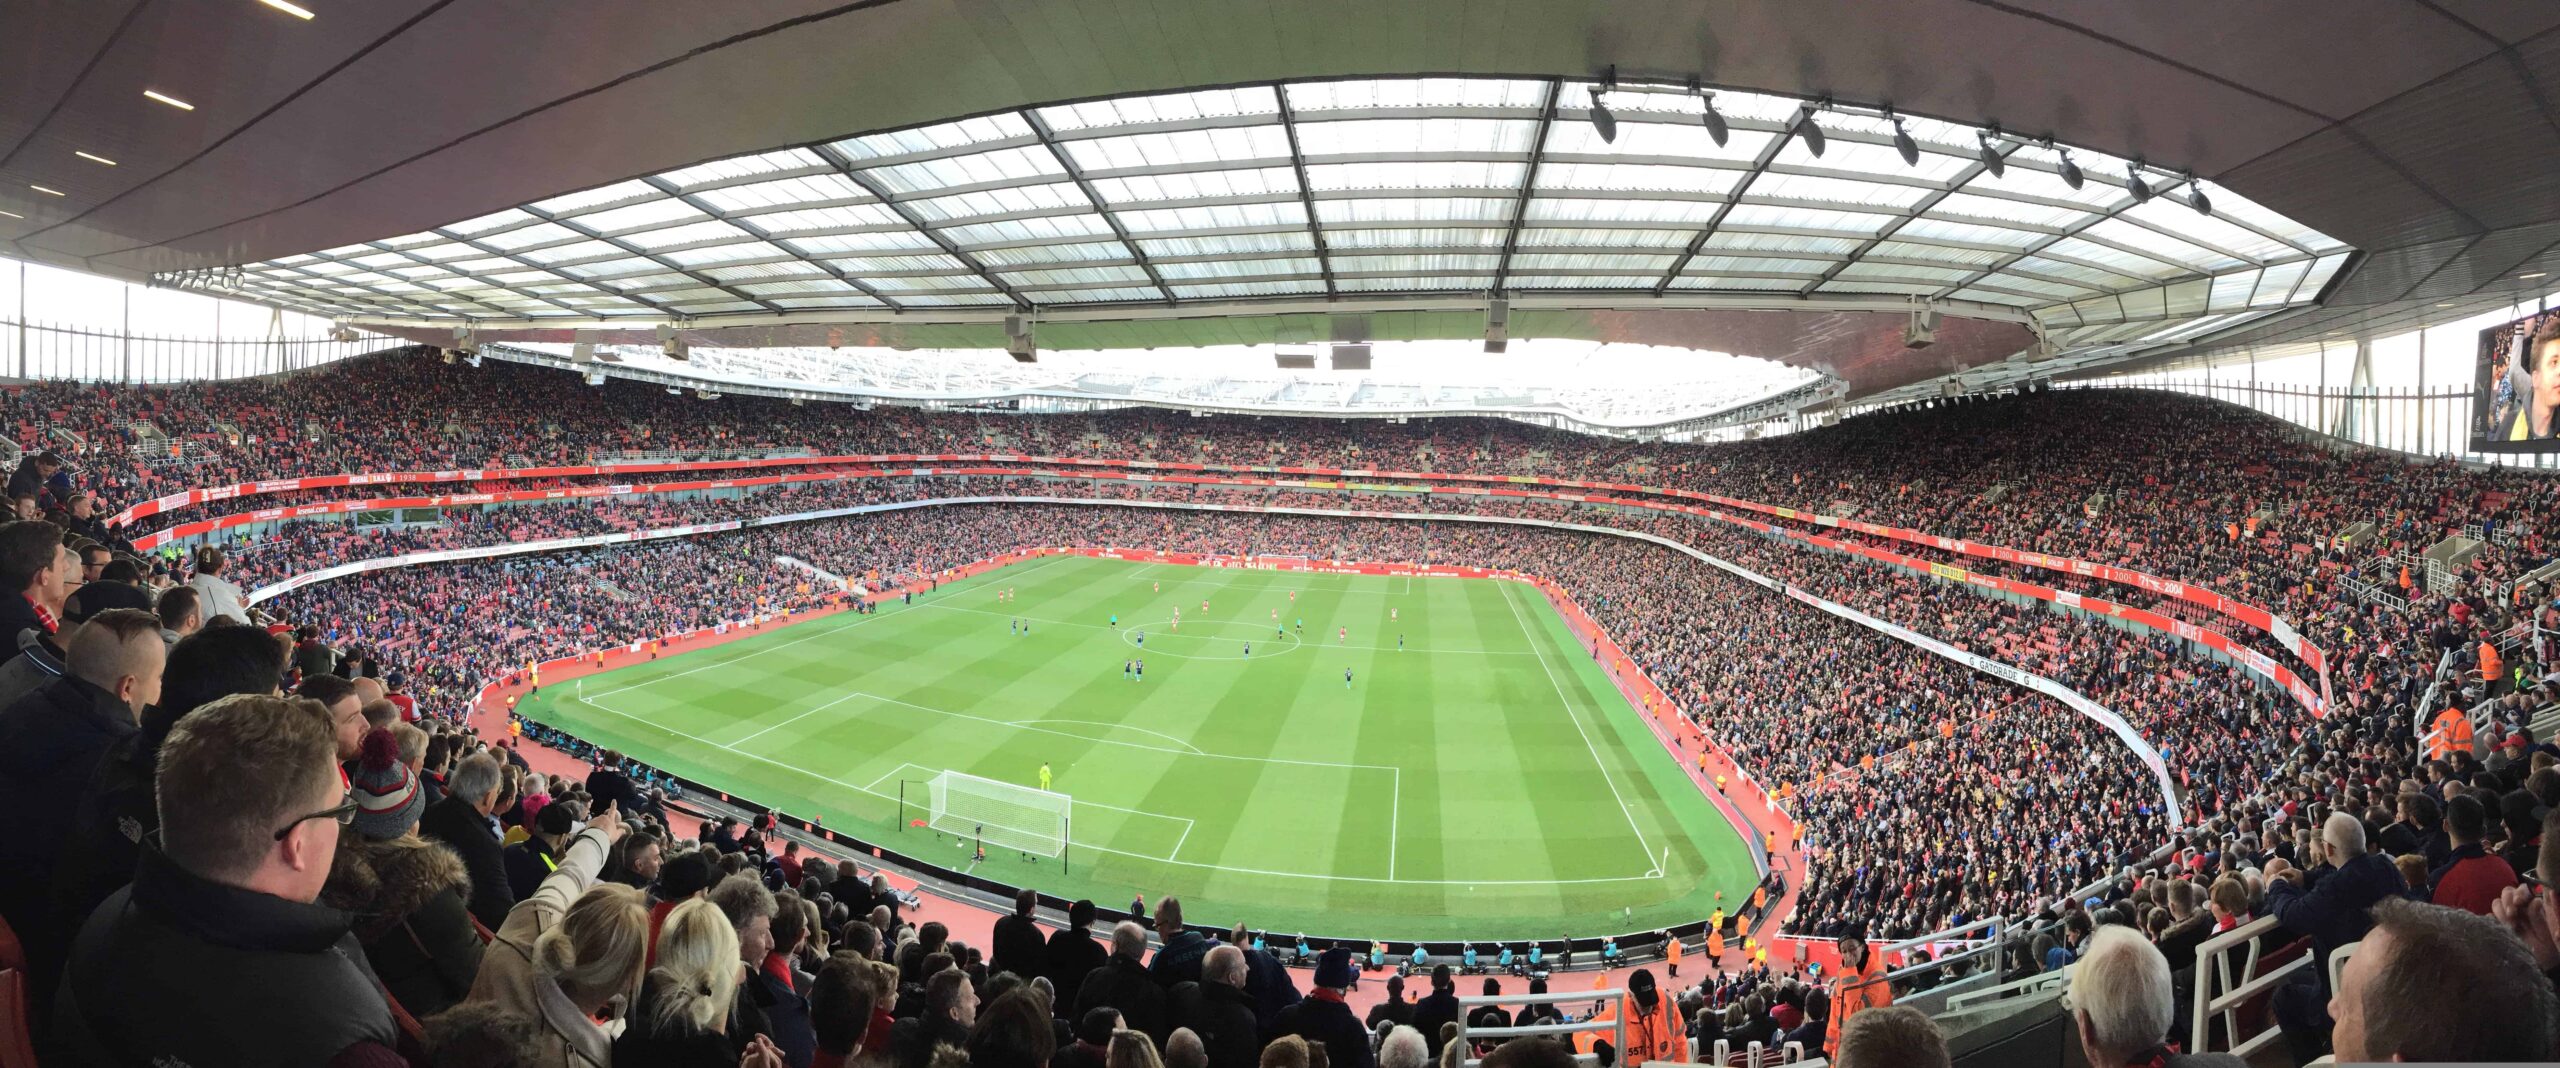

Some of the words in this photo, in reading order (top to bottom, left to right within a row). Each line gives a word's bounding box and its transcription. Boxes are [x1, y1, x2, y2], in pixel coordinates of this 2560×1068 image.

[296, 506, 328, 515] Arsenal.com
[1938, 537, 1952, 550] WHL
[2000, 551, 2013, 559] 2004
[2114, 572, 2132, 583] 2005
[2138, 574, 2148, 586] '71
[2164, 582, 2183, 596] 2004
[2226, 642, 2244, 661] Arsenal
[2304, 646, 2315, 666] 2015
[1980, 660, 2018, 681] GATORADE
